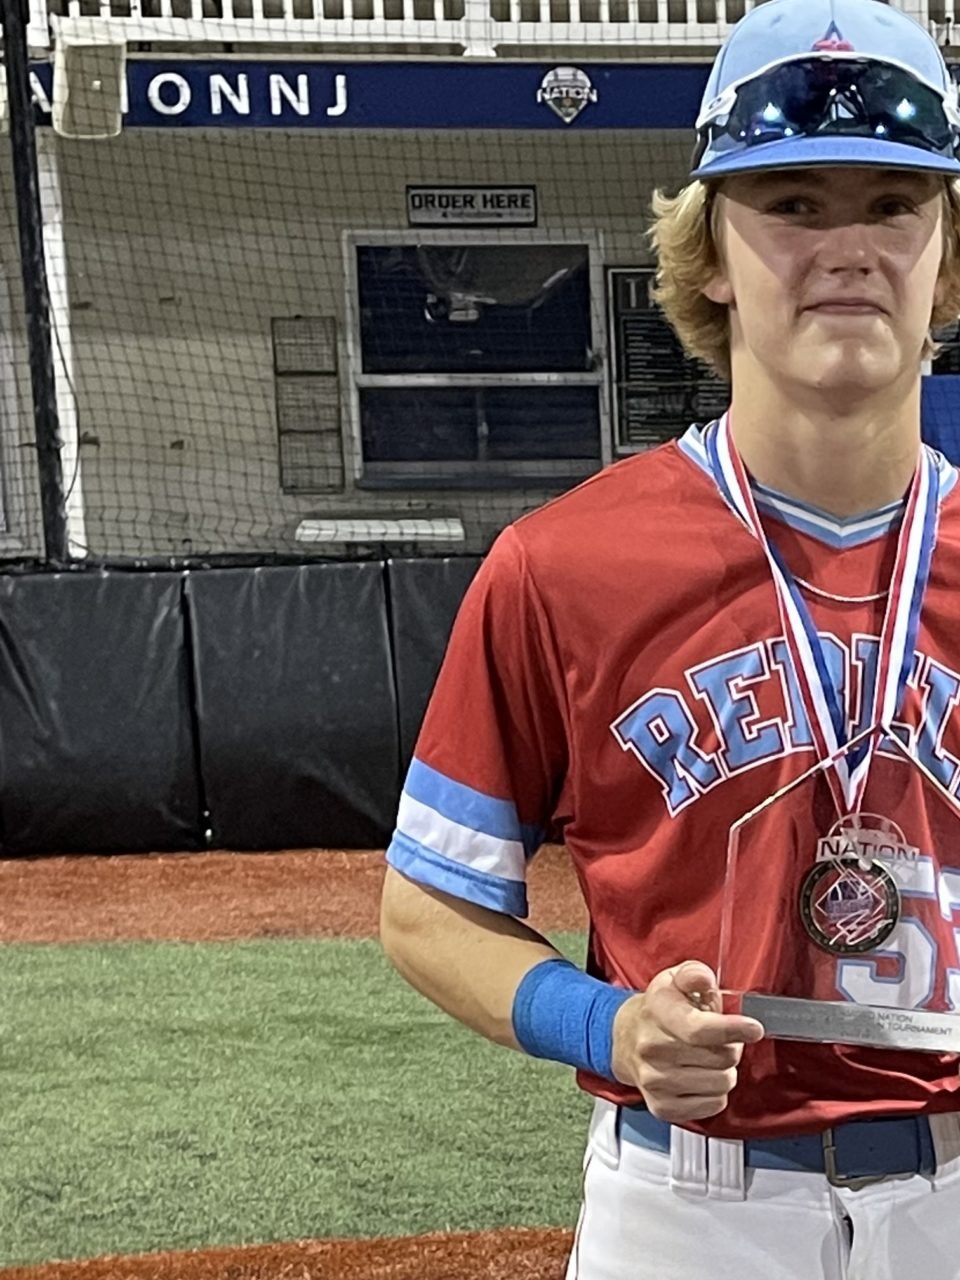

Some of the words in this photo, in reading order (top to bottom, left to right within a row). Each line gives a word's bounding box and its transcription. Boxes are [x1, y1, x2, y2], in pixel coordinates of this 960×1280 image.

[537, 88, 598, 103] NATION
[410, 193, 476, 209] ORDER
[481, 193, 532, 209] HERE
[820, 840, 917, 862] NATION
[877, 1012, 913, 1023] NATION
[887, 1022, 953, 1036] TOURNAMENT
